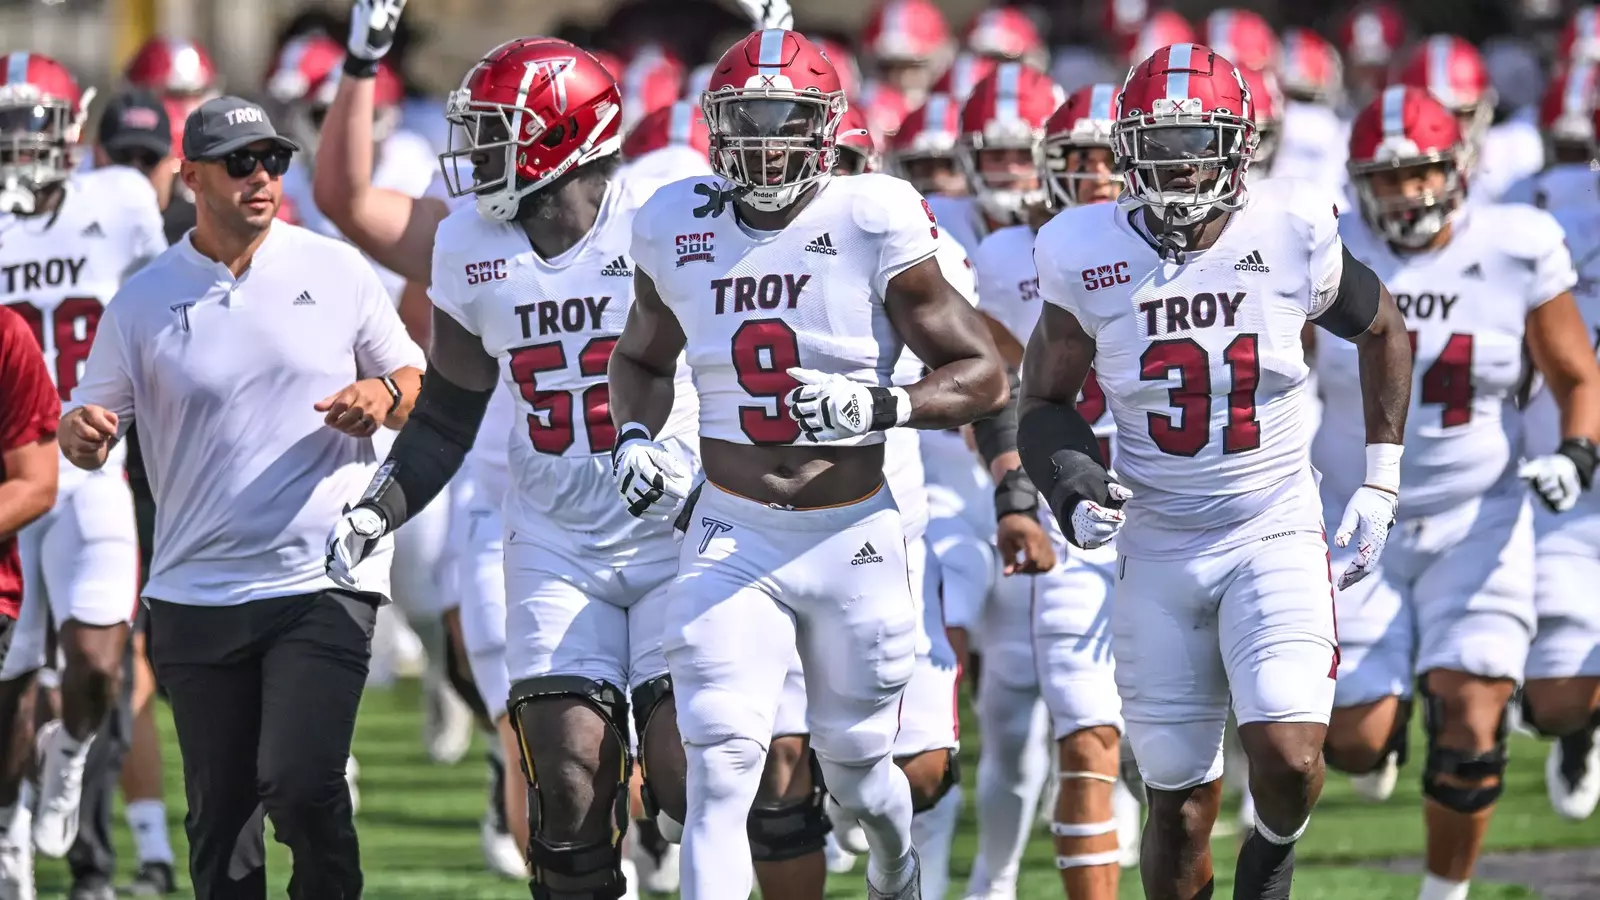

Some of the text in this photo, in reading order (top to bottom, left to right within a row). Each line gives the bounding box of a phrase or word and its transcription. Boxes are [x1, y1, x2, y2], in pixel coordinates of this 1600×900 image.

[224, 106, 263, 126] TROY
[675, 231, 715, 255] SBC
[804, 244, 838, 256] adidas
[1, 257, 86, 293] TROY
[465, 258, 508, 285] SBC
[601, 268, 634, 277] adidas
[1081, 261, 1131, 291] SBC
[1234, 262, 1270, 273] adidas
[711, 274, 811, 315] TROY
[1392, 292, 1459, 320] ROY
[514, 296, 612, 339] TROY
[1139, 292, 1247, 336] TROY
[731, 317, 802, 446] 9
[1407, 331, 1475, 428] 4
[1139, 333, 1261, 457] 31
[851, 393, 861, 428] adidas
[851, 555, 884, 566] adidas
